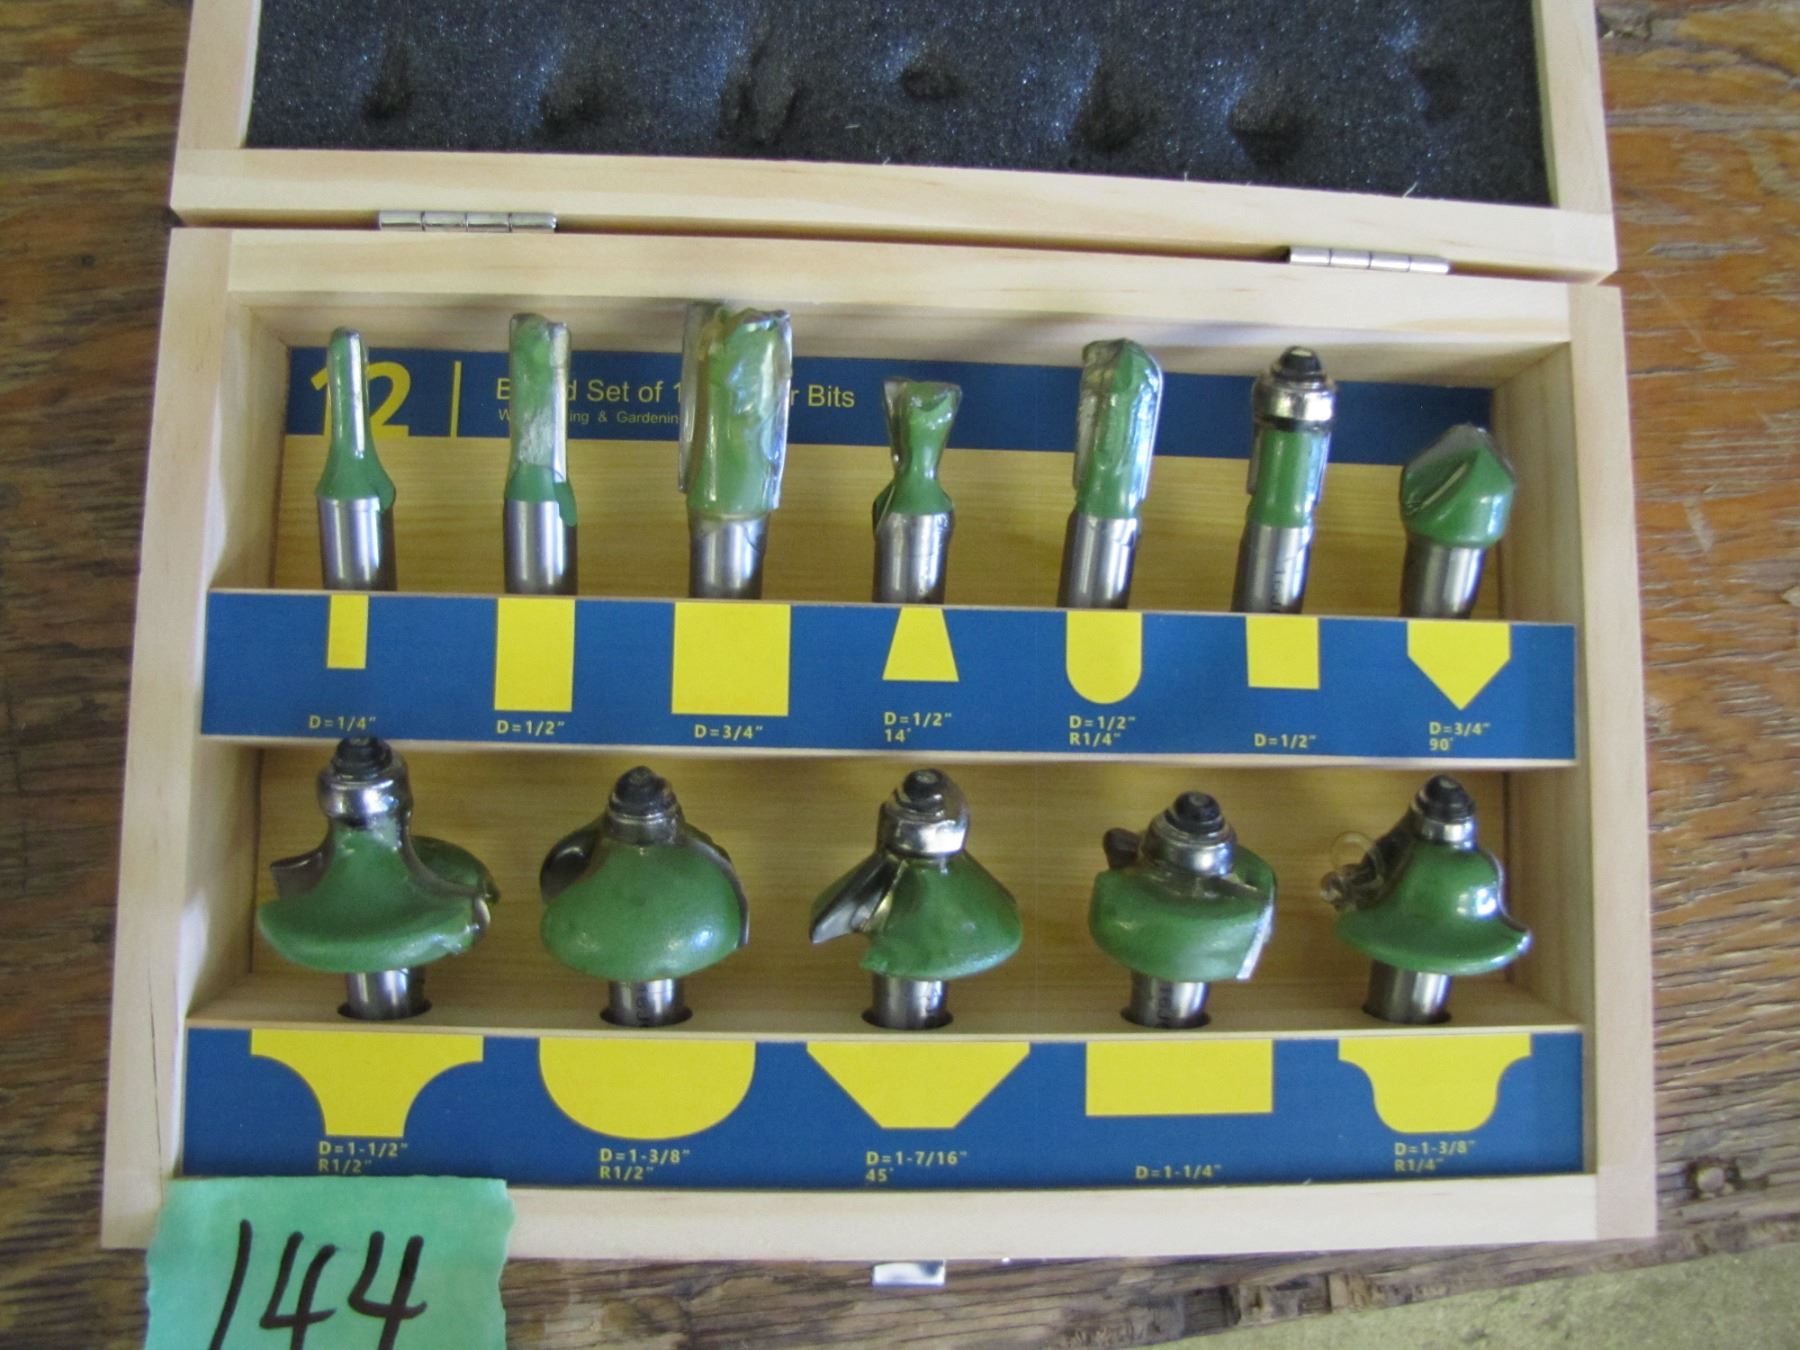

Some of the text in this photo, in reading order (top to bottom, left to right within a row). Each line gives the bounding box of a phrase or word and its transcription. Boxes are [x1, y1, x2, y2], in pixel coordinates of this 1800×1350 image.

[587, 379, 630, 402] Set
[638, 380, 664, 403] of
[808, 384, 855, 408] Bits
[598, 409, 608, 422] &
[616, 410, 680, 425] Gardenin
[207, 1219, 427, 1350] 144
